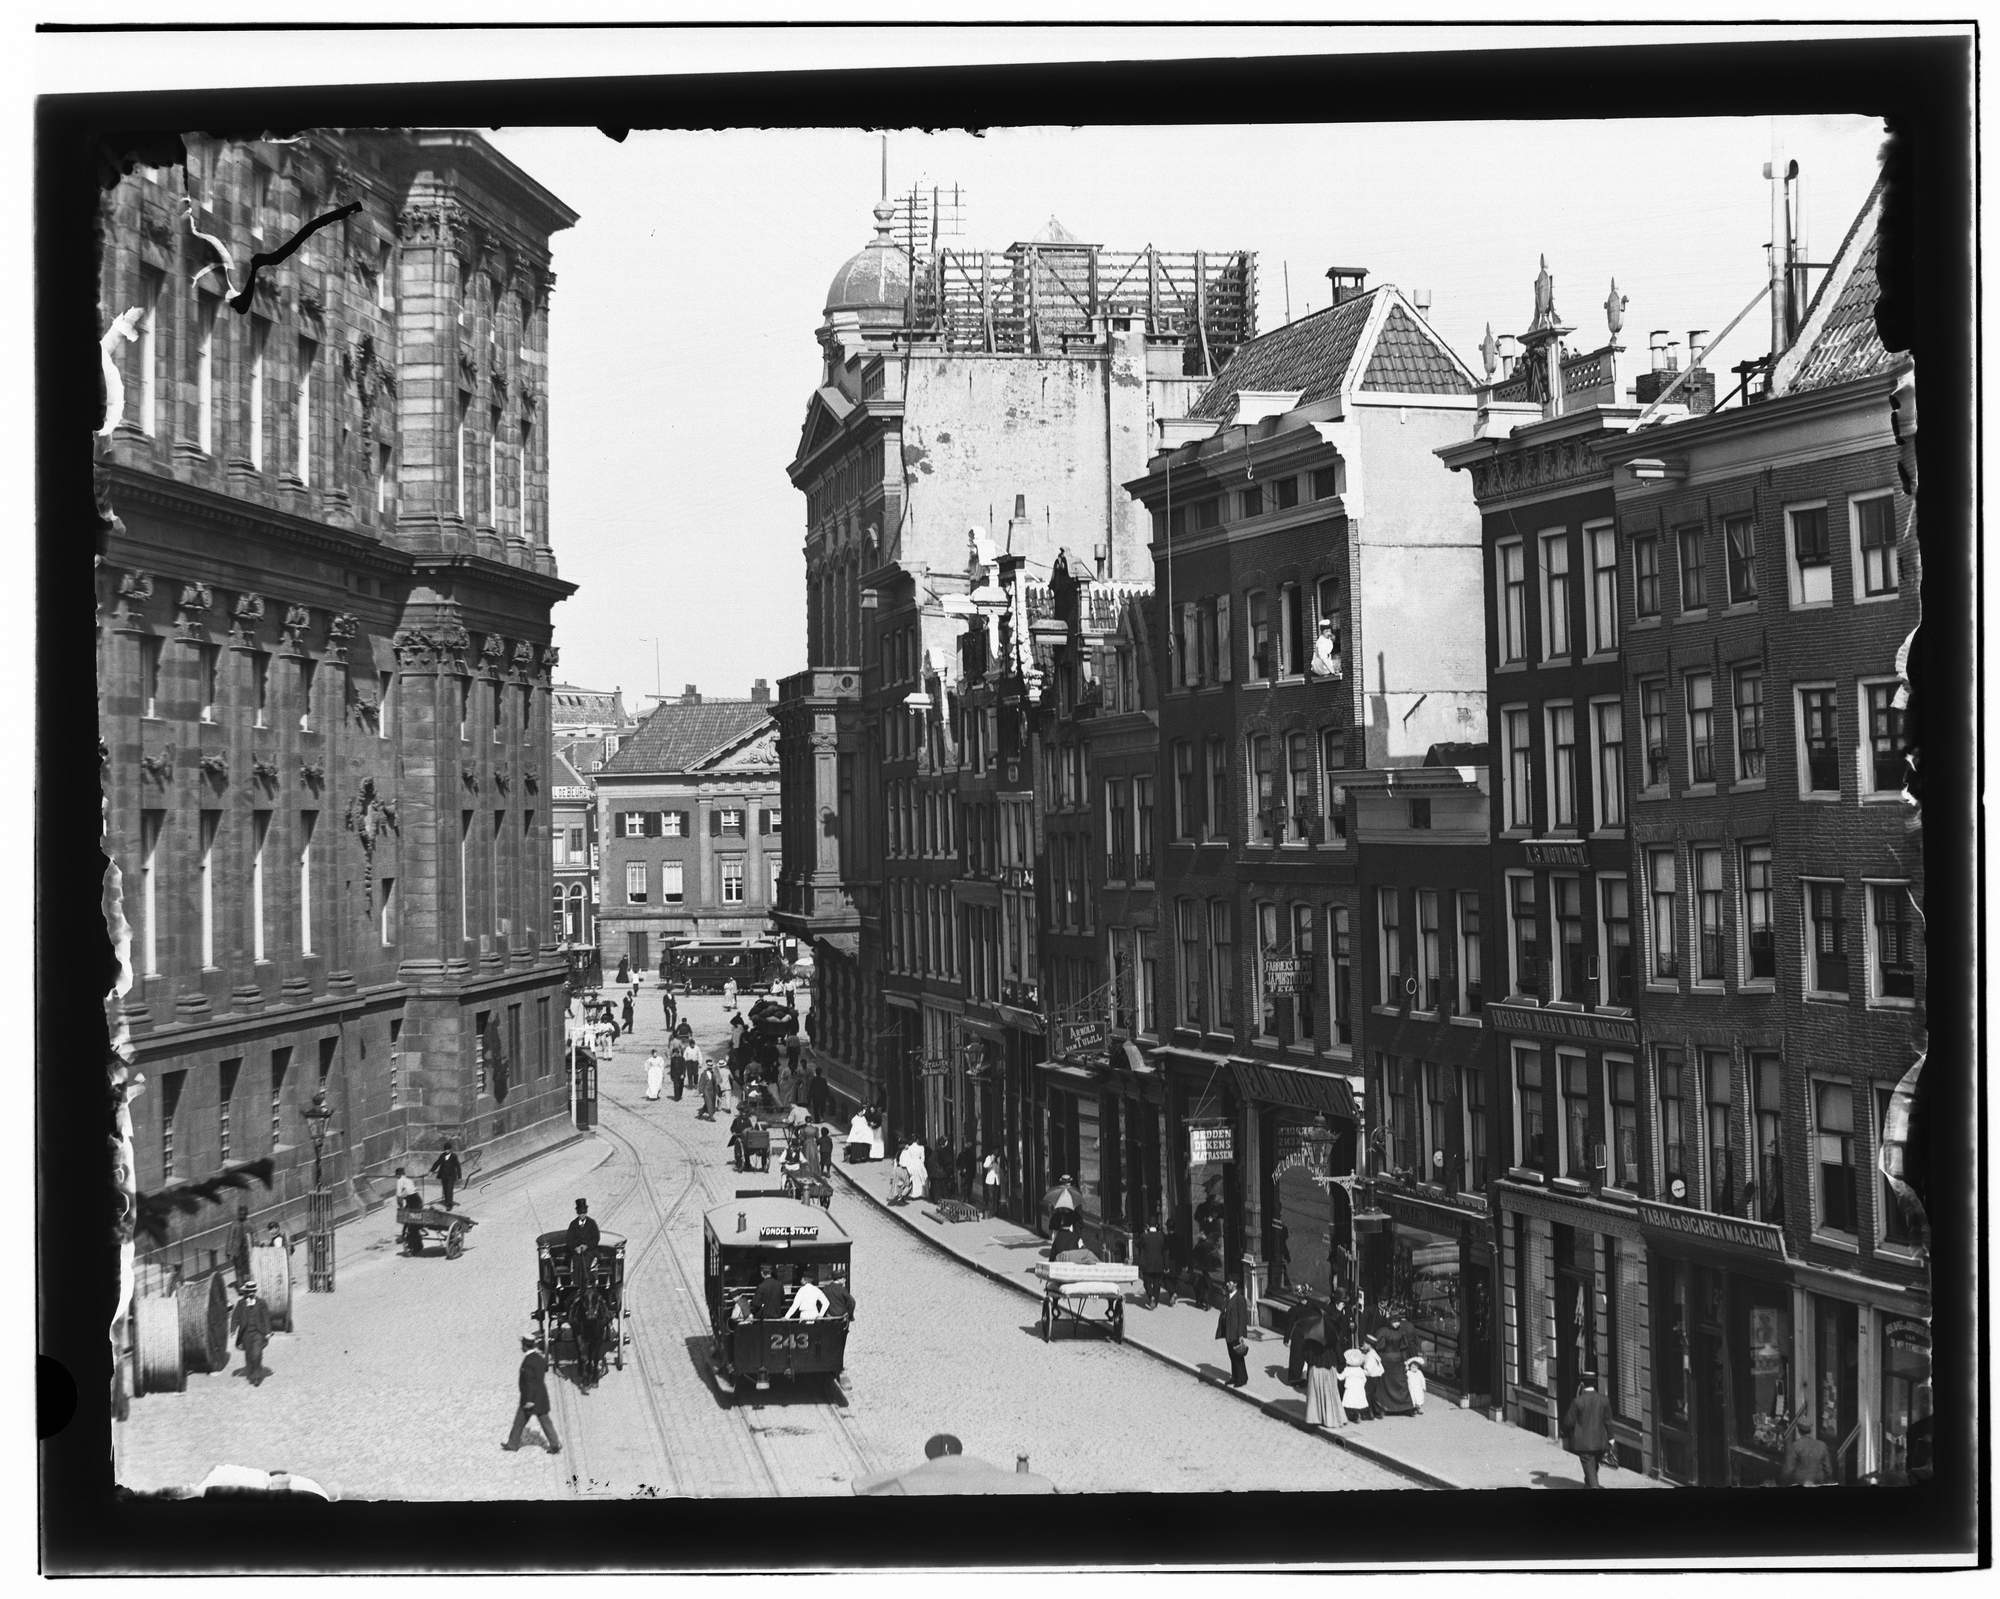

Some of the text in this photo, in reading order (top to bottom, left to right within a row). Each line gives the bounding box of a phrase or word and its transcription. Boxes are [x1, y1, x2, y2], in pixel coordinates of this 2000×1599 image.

[1070, 1024, 1096, 1039] ARNOLD
[1192, 1129, 1232, 1140] BEDDEN
[1194, 1140, 1231, 1151] DEKENS
[1192, 1150, 1234, 1161] MATRASSEN
[1282, 1151, 1306, 1171] LONDON
[760, 1226, 819, 1236] VONDEL STRAAT
[1640, 1206, 1673, 1230] TABAK
[1681, 1214, 1725, 1240] SIGAREN
[1723, 1222, 1780, 1251] MAGAZIJN
[770, 1333, 809, 1350] 243
